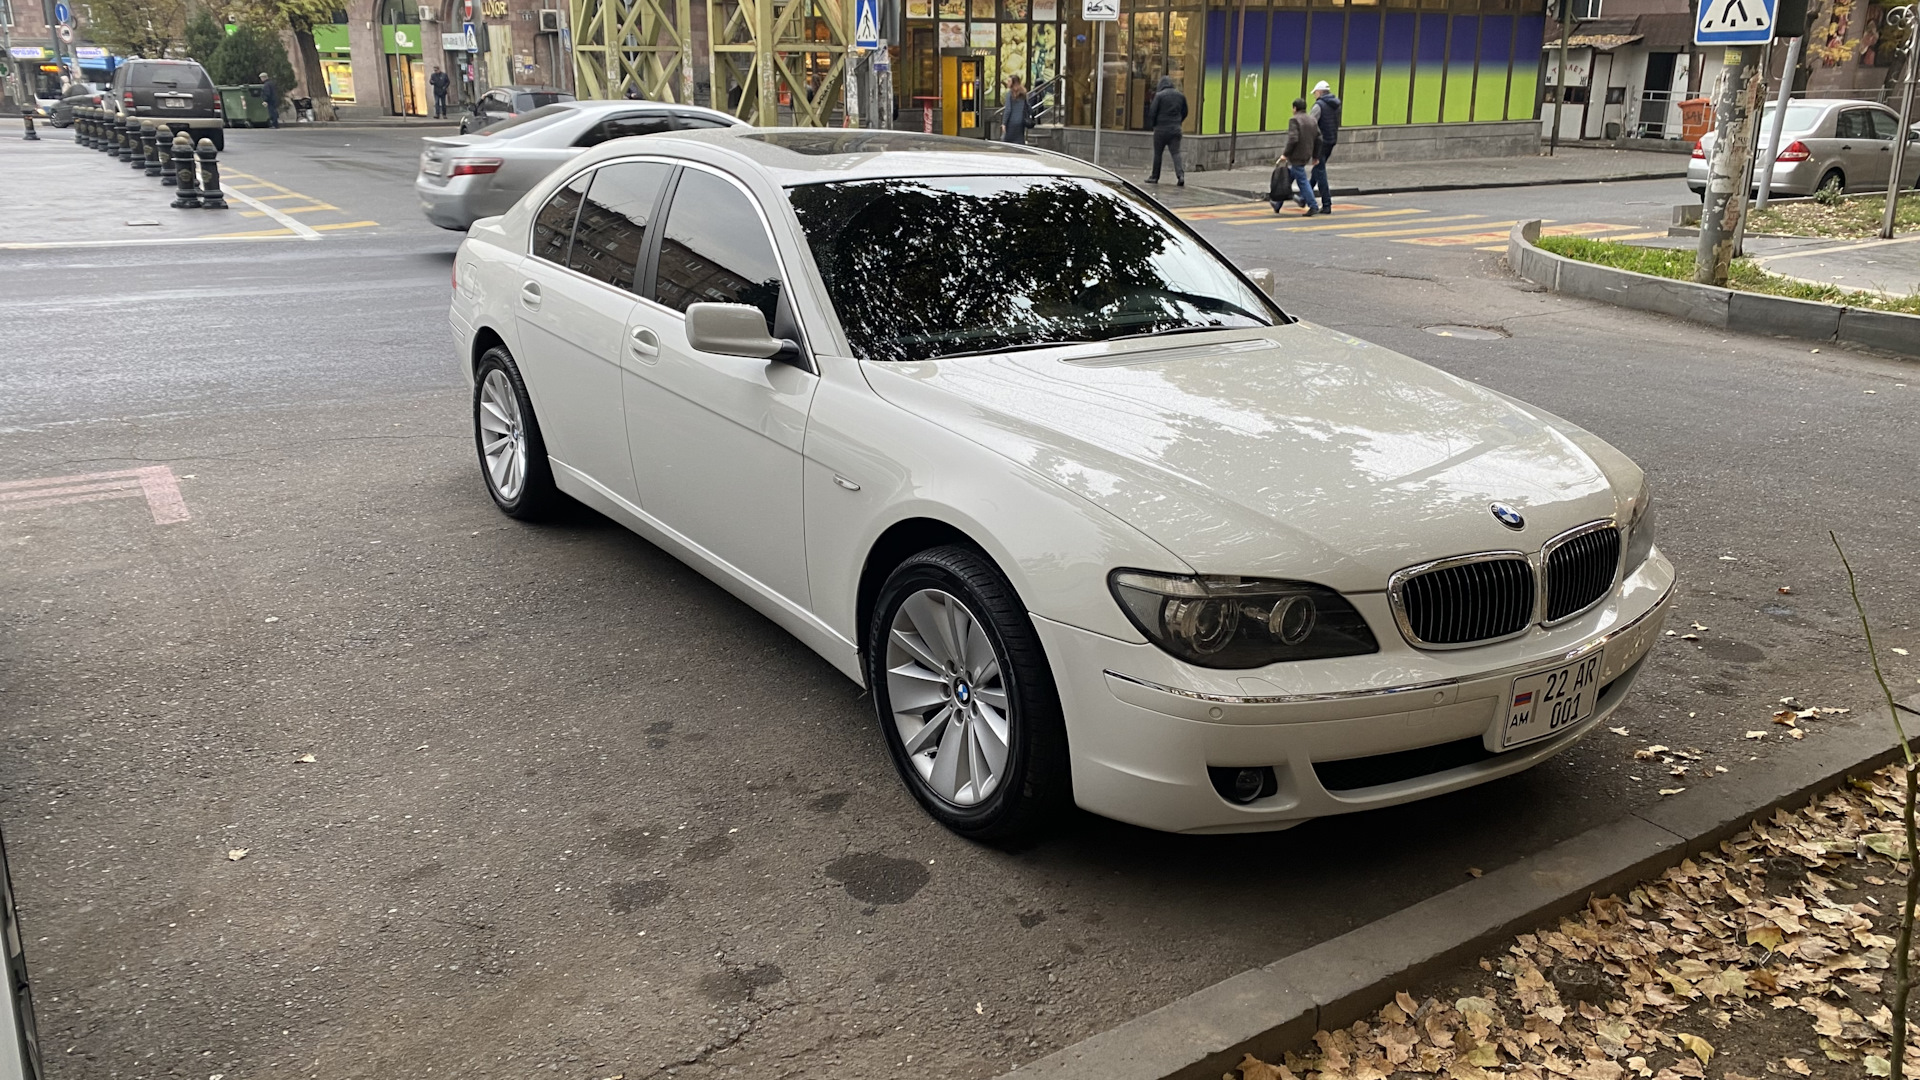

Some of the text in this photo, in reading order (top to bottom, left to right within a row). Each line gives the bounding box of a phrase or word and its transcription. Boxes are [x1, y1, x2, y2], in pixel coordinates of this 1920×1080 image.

[481, 0, 508, 18] LUXOR
[1543, 657, 1598, 703] 22 AR
[1509, 710, 1530, 729] AM
[1549, 692, 1581, 729] 001
